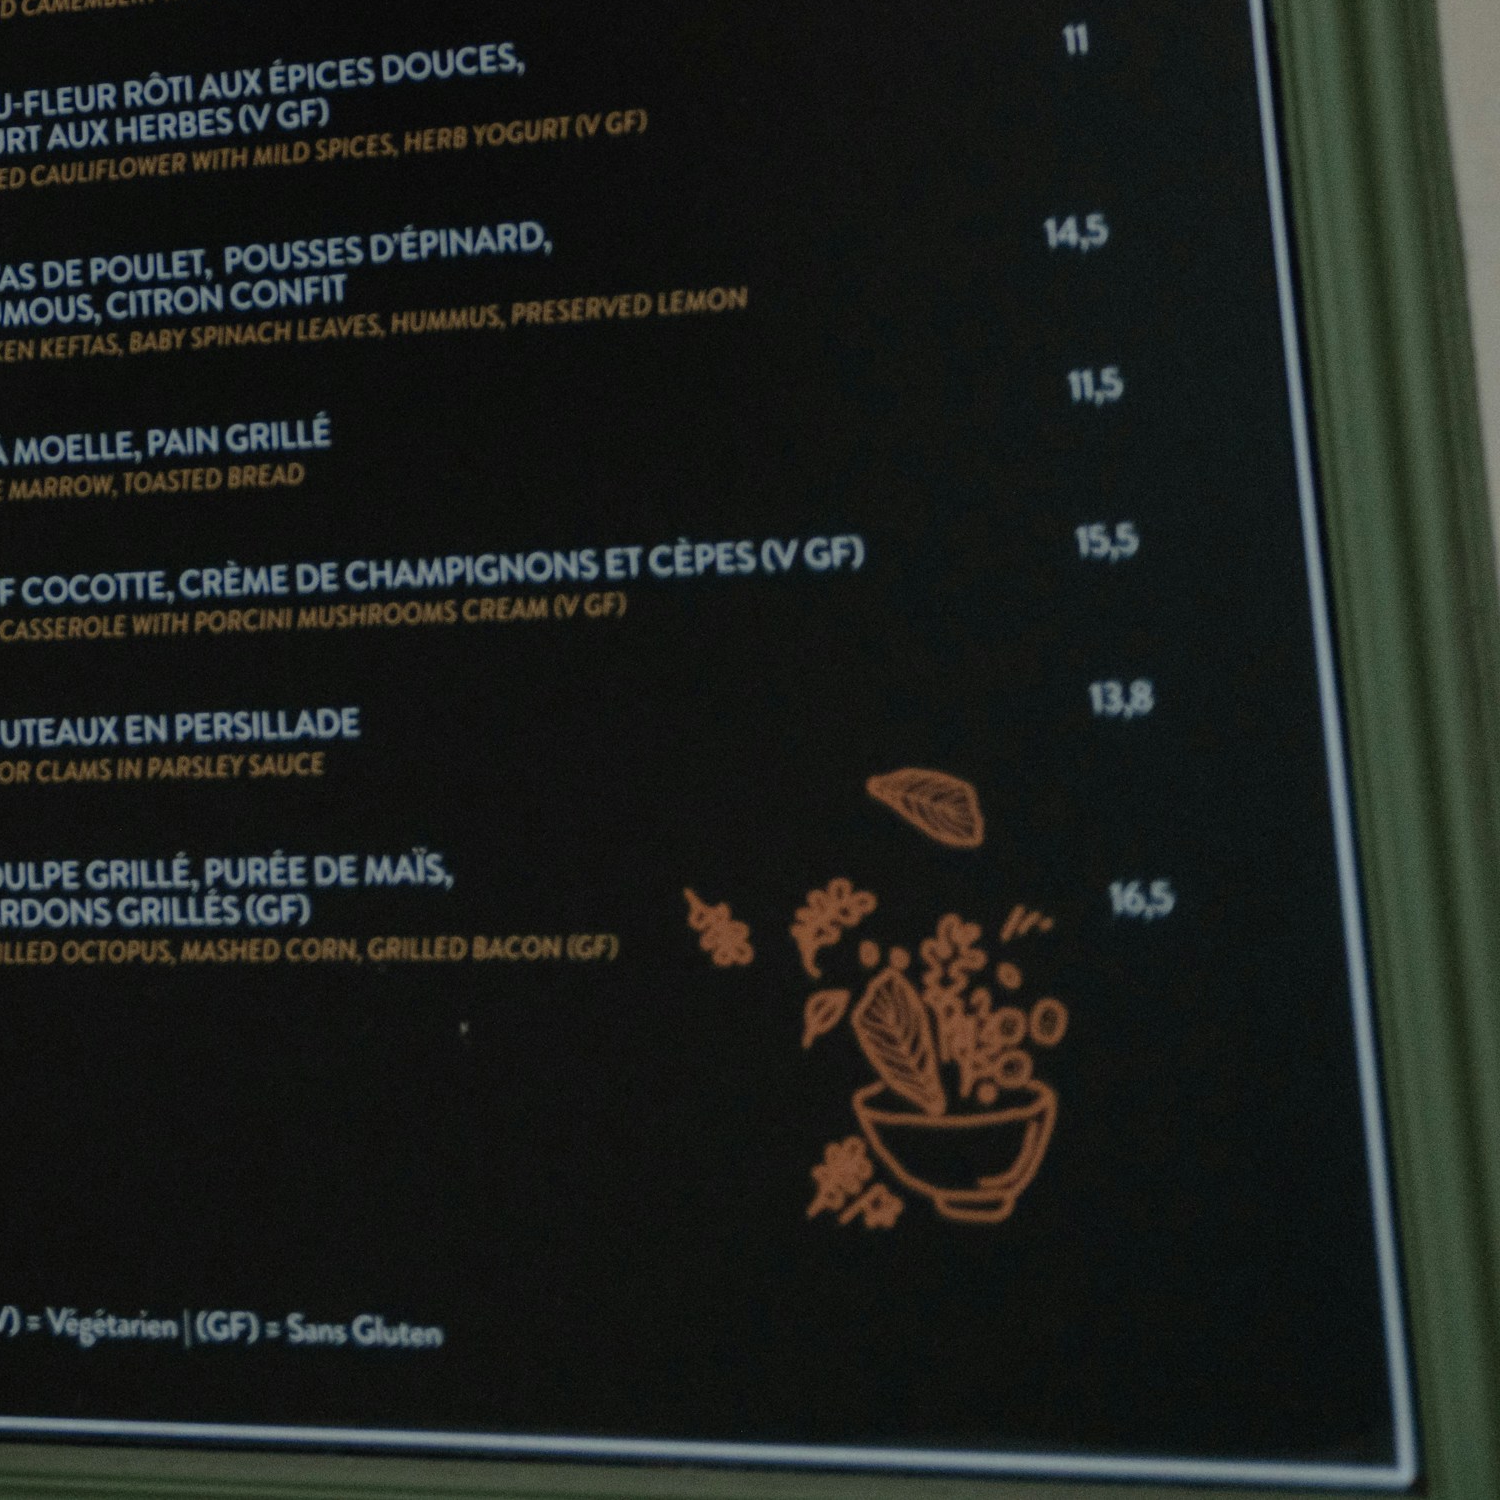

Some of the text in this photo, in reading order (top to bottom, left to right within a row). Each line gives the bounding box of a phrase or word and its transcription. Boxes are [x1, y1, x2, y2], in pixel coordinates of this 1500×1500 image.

[1062, 23, 1089, 55] 11
[123, 71, 194, 108] RÔTI
[198, 68, 263, 101] AUX
[268, 56, 376, 95] ÉPICES
[381, 42, 526, 84] DOUCES,
[46, 118, 109, 151] AUX
[115, 106, 235, 144] HERBES
[238, 103, 272, 134] (V
[276, 97, 330, 130] GF)
[29, 151, 188, 187] CAULIFLOWER
[191, 147, 250, 170] WITH
[252, 140, 311, 166] MILD
[314, 131, 398, 163] SPICES,
[403, 125, 469, 153] HERB
[472, 115, 572, 147] YOGURT
[574, 113, 602, 138] (V
[604, 108, 649, 136] GF)
[1043, 212, 1109, 252] 14,5
[41, 258, 83, 290] DE
[89, 248, 213, 285] POULET,
[223, 235, 365, 274] POUSSES
[369, 220, 553, 264] D’ÉPINARD,
[105, 283, 224, 320] CITRON
[229, 273, 347, 311] CONFIT
[39, 332, 124, 360] KEFTAS,
[127, 328, 187, 354] BABY
[190, 320, 293, 349] SPINACH
[296, 311, 386, 342] LEAVES,
[390, 303, 506, 334] HUMMUS,
[510, 292, 653, 325] PRESERVED
[657, 286, 749, 316] LEMON
[1067, 365, 1125, 406] 11,5
[13, 430, 143, 465] MOELLE,
[147, 425, 220, 457] PAIN
[224, 411, 331, 454] GRILLÉ
[7, 474, 118, 501] MARROW,
[123, 467, 224, 495] TOASTED
[227, 462, 306, 490] BREAD
[1075, 521, 1140, 562] 15,5
[21, 570, 176, 606] COCOTTE,
[178, 560, 290, 600] CRÈME
[295, 561, 340, 594] DE
[344, 548, 600, 592] CHAMPIGNONS
[604, 545, 643, 580] ET
[648, 537, 757, 578] CÈPES
[760, 538, 799, 573] (V
[803, 534, 866, 571] GF)
[131, 612, 190, 635] WITH
[193, 607, 293, 634] PORCINI
[296, 599, 458, 630] MUSHROOMS
[461, 596, 549, 623] CREAM
[552, 593, 581, 618] (V
[583, 591, 628, 618] GF)
[1088, 679, 1155, 719] 13,8
[124, 714, 169, 745] EN
[174, 706, 361, 743] PERSILLADE
[34, 757, 114, 784] CLAMS
[116, 758, 143, 780] IN
[146, 754, 246, 779] PARSLEY
[247, 751, 324, 778] SAUCE
[84, 851, 200, 893] GRILLÉ,
[204, 849, 308, 889] PURÉE
[313, 854, 358, 887] DE
[364, 847, 454, 889] MAÏS,
[115, 888, 242, 928] GRILLÉS
[244, 892, 312, 927] (GF)
[1109, 879, 1176, 920] 16,5
[60, 938, 176, 965] OCTOPUS,
[180, 937, 282, 964] MASHED
[284, 936, 363, 963] CORN,
[366, 935, 469, 962] GRILLED
[471, 935, 563, 962] BACON
[565, 934, 620, 960] (GF)
[46, 1307, 179, 1348] Végétarien
[195, 1310, 260, 1344] (GF)
[286, 1312, 349, 1345] Sans
[350, 1313, 444, 1348] Gluten
